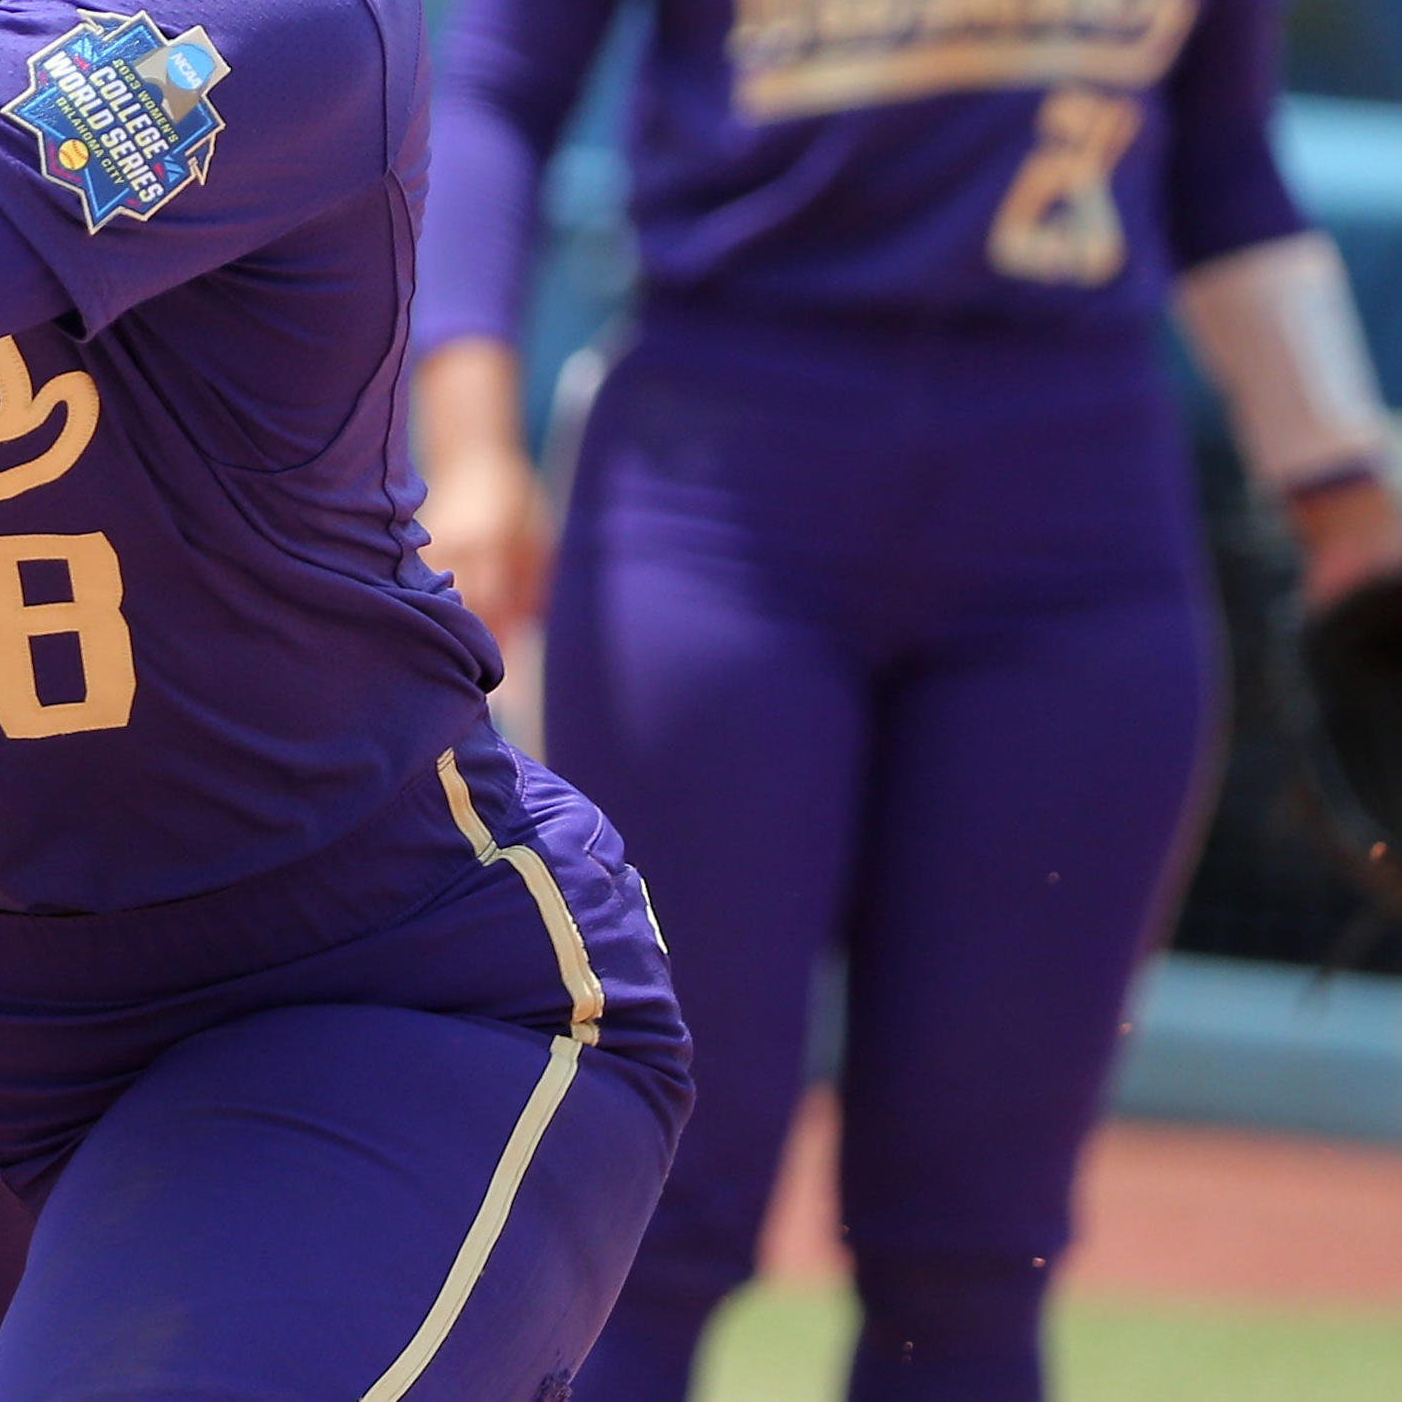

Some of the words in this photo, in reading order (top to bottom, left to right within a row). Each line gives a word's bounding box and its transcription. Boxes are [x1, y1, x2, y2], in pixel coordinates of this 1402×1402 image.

[88, 65, 170, 160] COLLEGE
[112, 58, 142, 90] 2023
[137, 89, 179, 144] WOMEN'S
[169, 51, 204, 91] NCAA
[42, 50, 115, 131] WORLD
[100, 126, 165, 203] SERIES
[55, 96, 104, 159] OKLAHOMA
[101, 159, 126, 186] CITY
